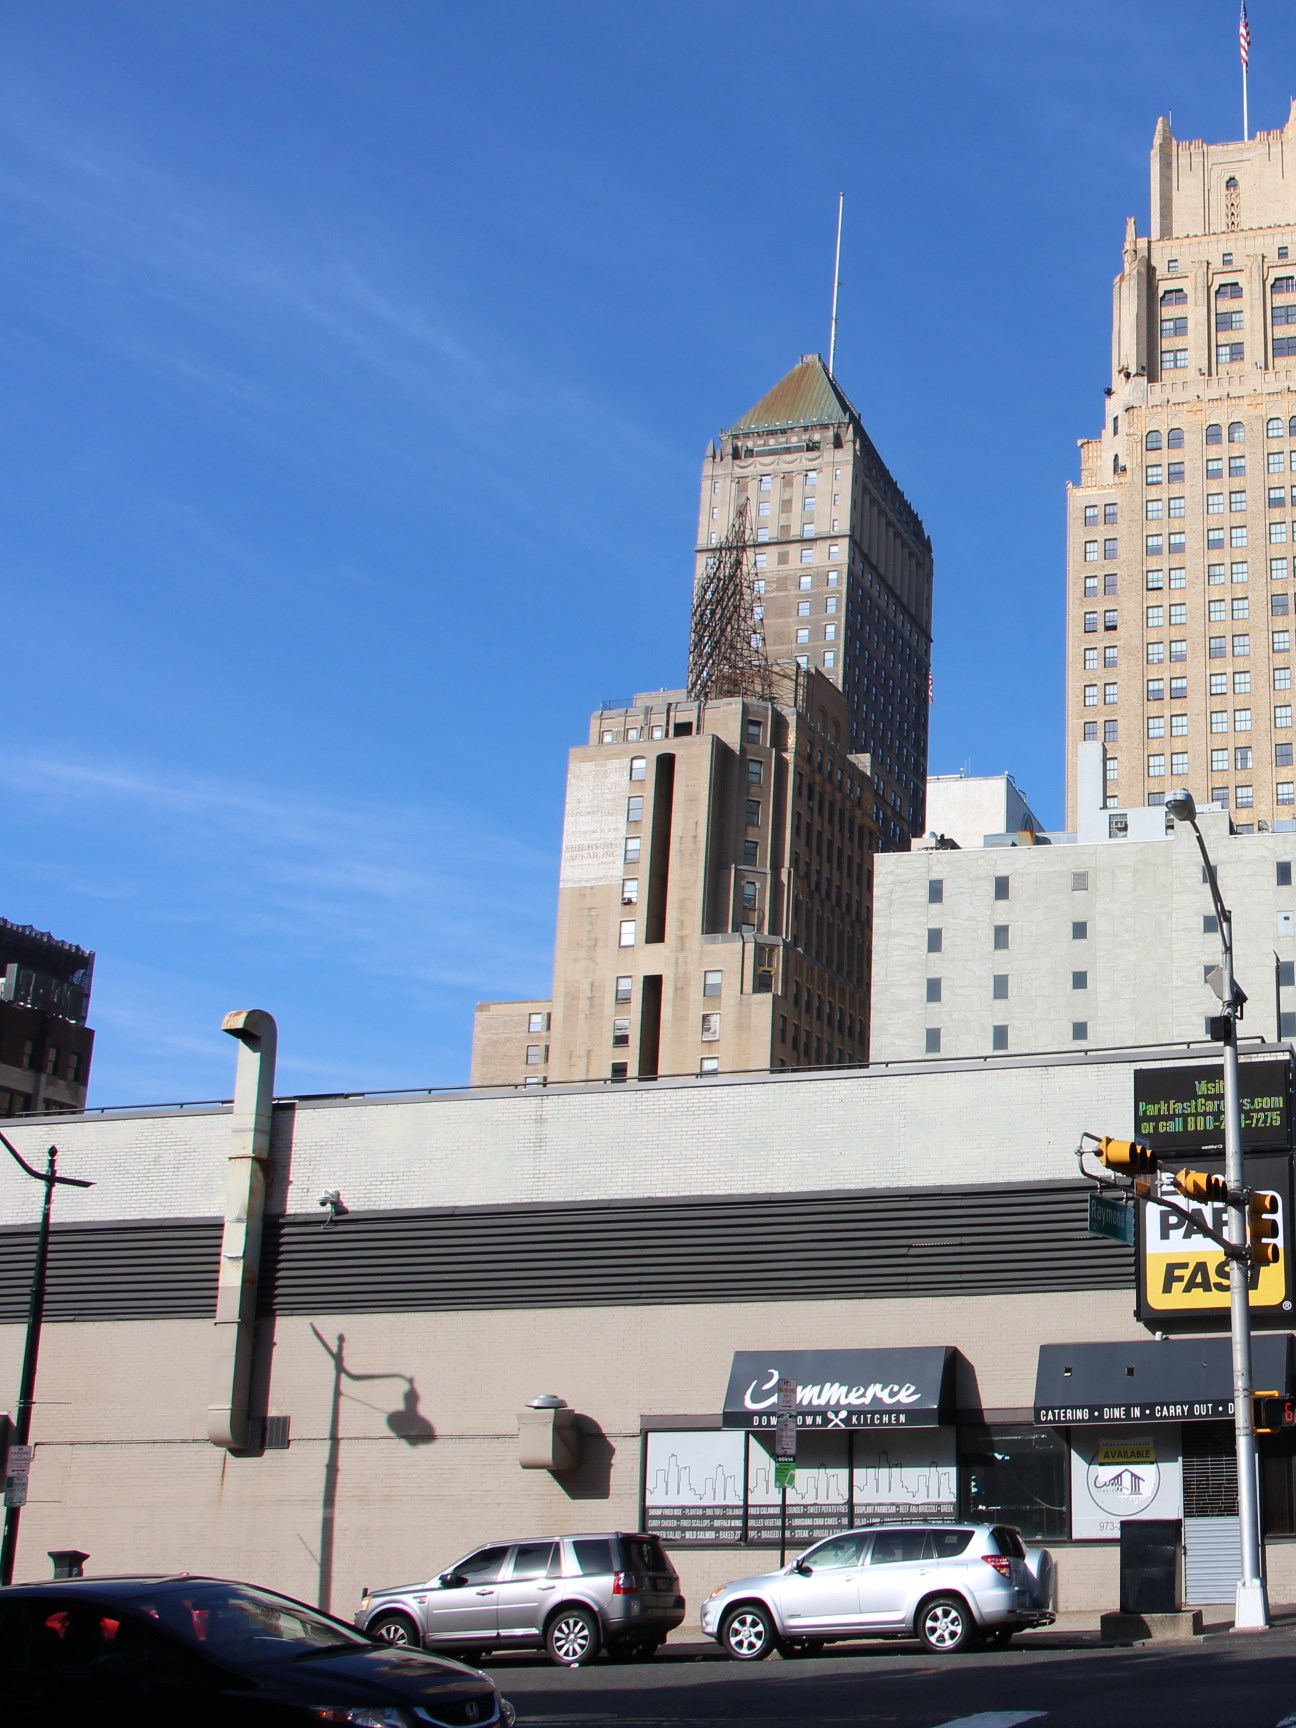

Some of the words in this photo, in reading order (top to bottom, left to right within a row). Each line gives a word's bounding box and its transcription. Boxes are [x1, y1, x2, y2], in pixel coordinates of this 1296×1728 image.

[1141, 1122, 1155, 1134] or
[1158, 1117, 1184, 1133] call
[1091, 1200, 1125, 1228] Raymond
[744, 1369, 922, 1410] Cmmerce
[753, 1415, 822, 1426] DOWOWN
[852, 1413, 906, 1425] KITCHEN
[1040, 1407, 1089, 1421] CATERING
[1103, 1406, 1126, 1420] DINE
[1130, 1405, 1141, 1418] IN
[1155, 1404, 1189, 1417] CARRY
[1194, 1403, 1213, 1415] OUT
[1284, 1402, 1293, 1422] 6
[1104, 1450, 1151, 1459] AVAILABLE
[837, 1505, 848, 1513] FRIES
[854, 1505, 874, 1514] EGGPLANT
[875, 1505, 896, 1514] PARMESAN
[899, 1505, 909, 1513] BEEF
[919, 1505, 937, 1513] BROCCOLI
